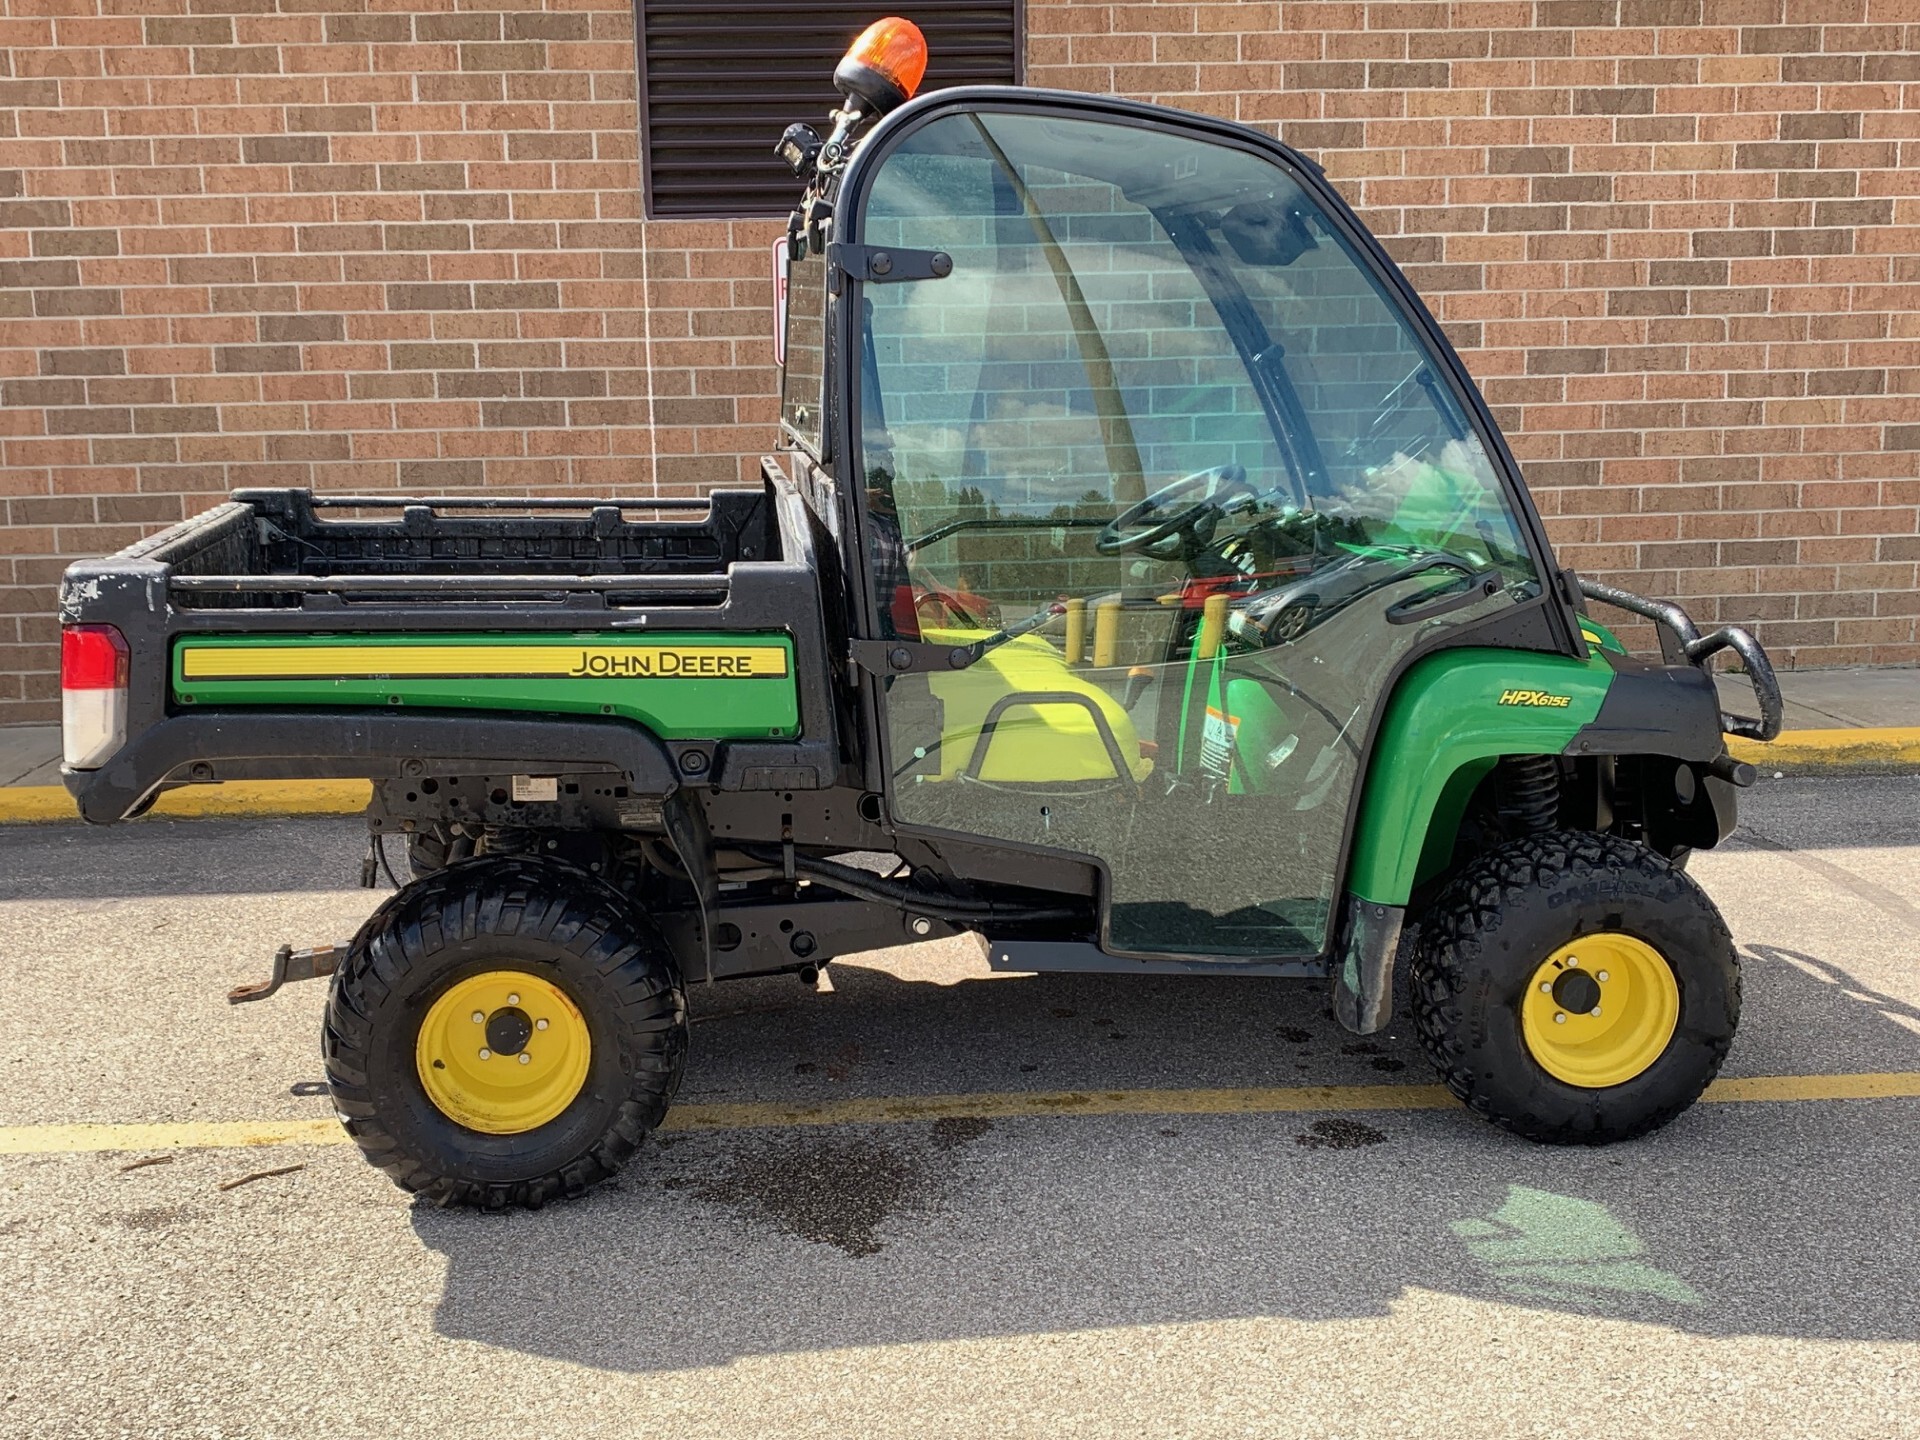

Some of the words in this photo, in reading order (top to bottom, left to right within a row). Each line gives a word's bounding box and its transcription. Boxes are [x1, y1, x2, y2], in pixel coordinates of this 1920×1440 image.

[572, 651, 650, 673] JOHN
[659, 651, 752, 673] DEERE
[1498, 689, 1571, 708] HPX615E
